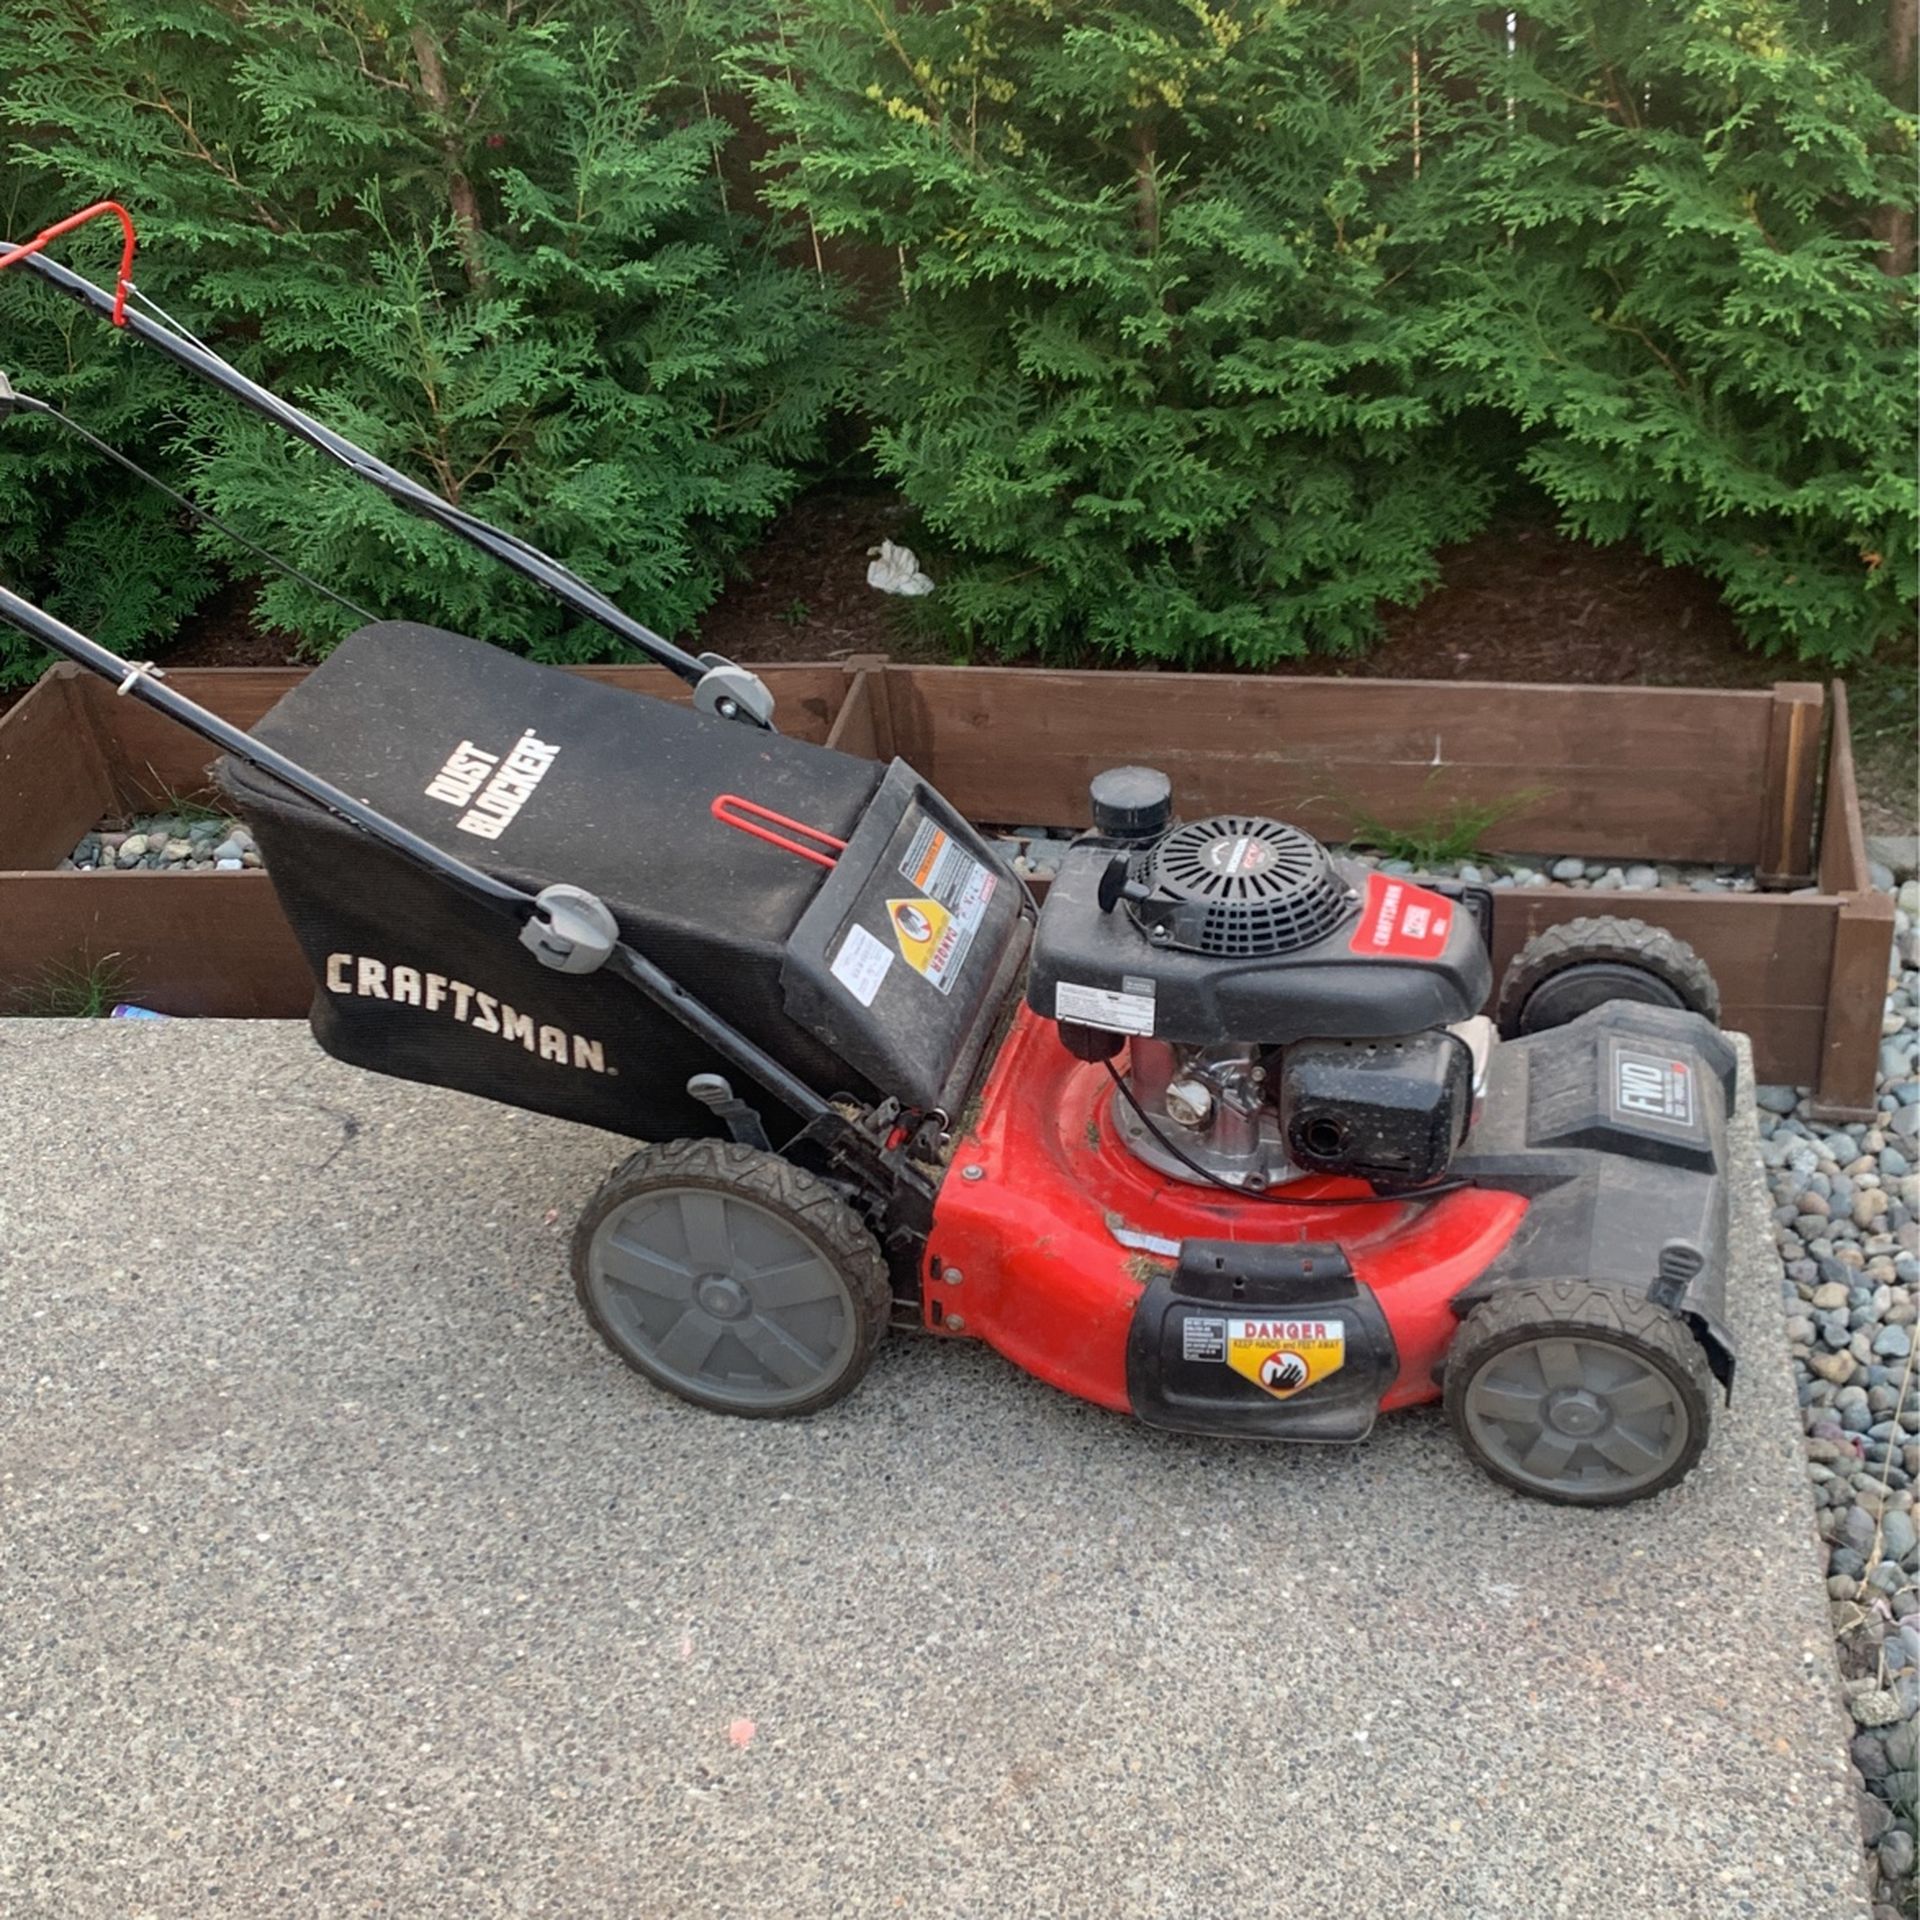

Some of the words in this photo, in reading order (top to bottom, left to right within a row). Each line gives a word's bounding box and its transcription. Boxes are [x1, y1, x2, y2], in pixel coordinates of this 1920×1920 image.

[424, 740, 500, 808] DUST
[456, 732, 562, 840] BLOCKER
[930, 926, 957, 973] DANGER
[326, 952, 608, 1076] CRAFTSMAN
[1621, 1062, 1664, 1113] FWD
[1244, 1322, 1327, 1339] DANGER
